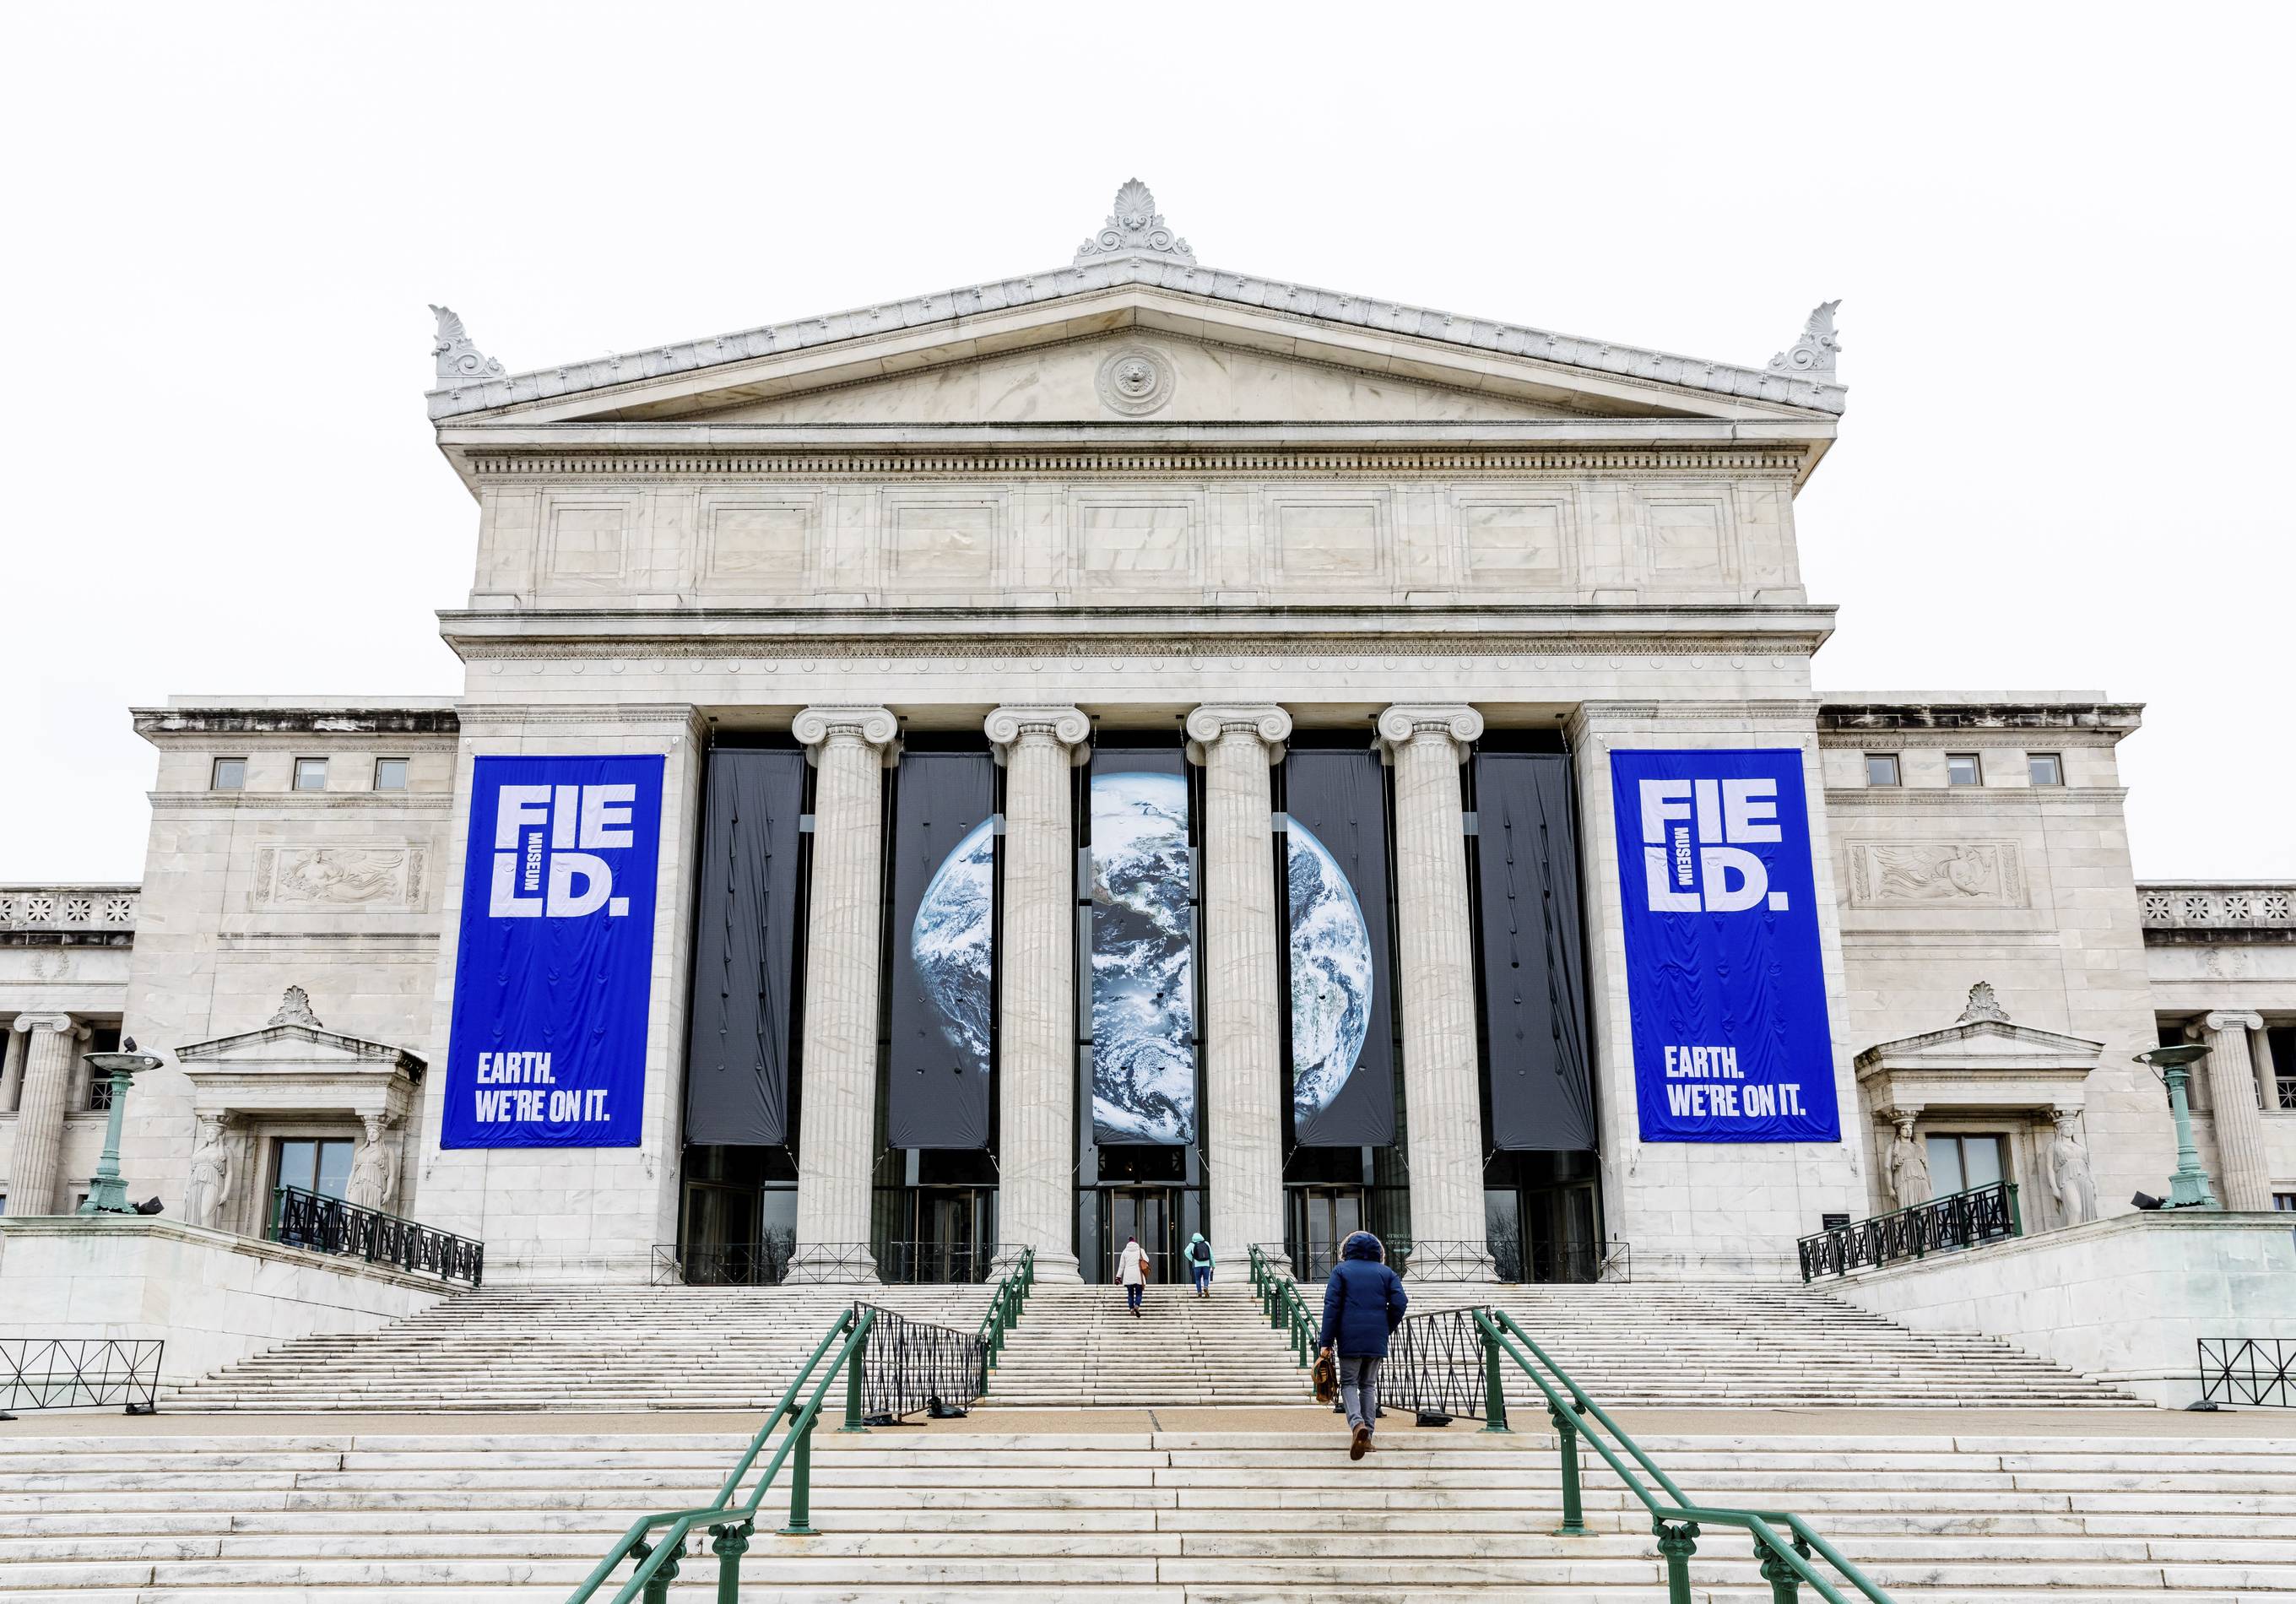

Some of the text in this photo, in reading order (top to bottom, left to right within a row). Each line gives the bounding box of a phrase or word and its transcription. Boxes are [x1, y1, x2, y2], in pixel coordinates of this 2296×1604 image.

[525, 832, 543, 890] MUSEUM
[1675, 827, 1692, 885] MUSEUM
[478, 1052, 555, 1083] EARTH.
[1665, 1046, 1744, 1078] EARTH.
[476, 1090, 609, 1122] WE'RE ON IT.
[1667, 1084, 1806, 1117] WE'RE ON IT.
